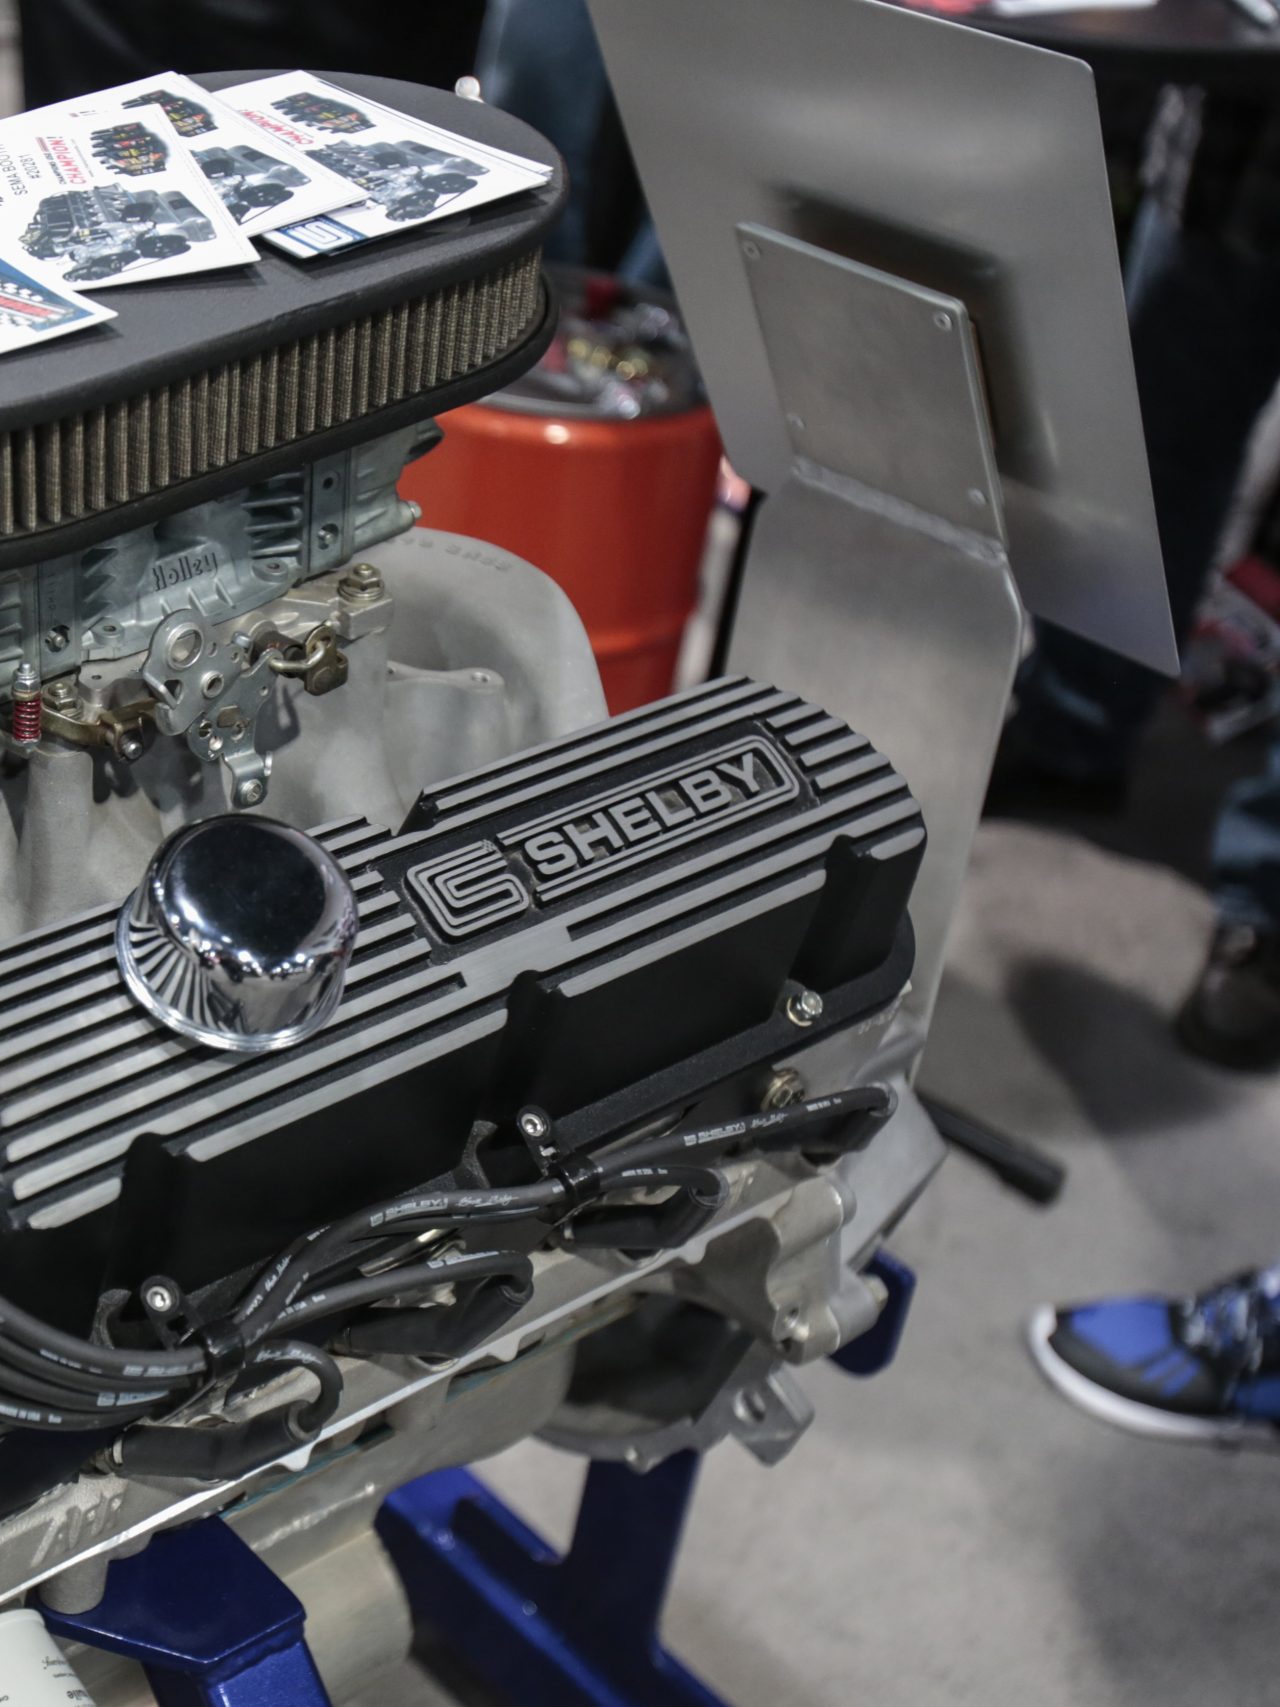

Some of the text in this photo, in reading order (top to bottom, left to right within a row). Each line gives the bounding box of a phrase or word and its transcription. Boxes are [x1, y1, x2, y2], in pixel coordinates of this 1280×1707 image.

[46, 136, 87, 184] CHAMPION!
[6, 173, 28, 196] SEMA
[525, 752, 765, 876] SHELBY
